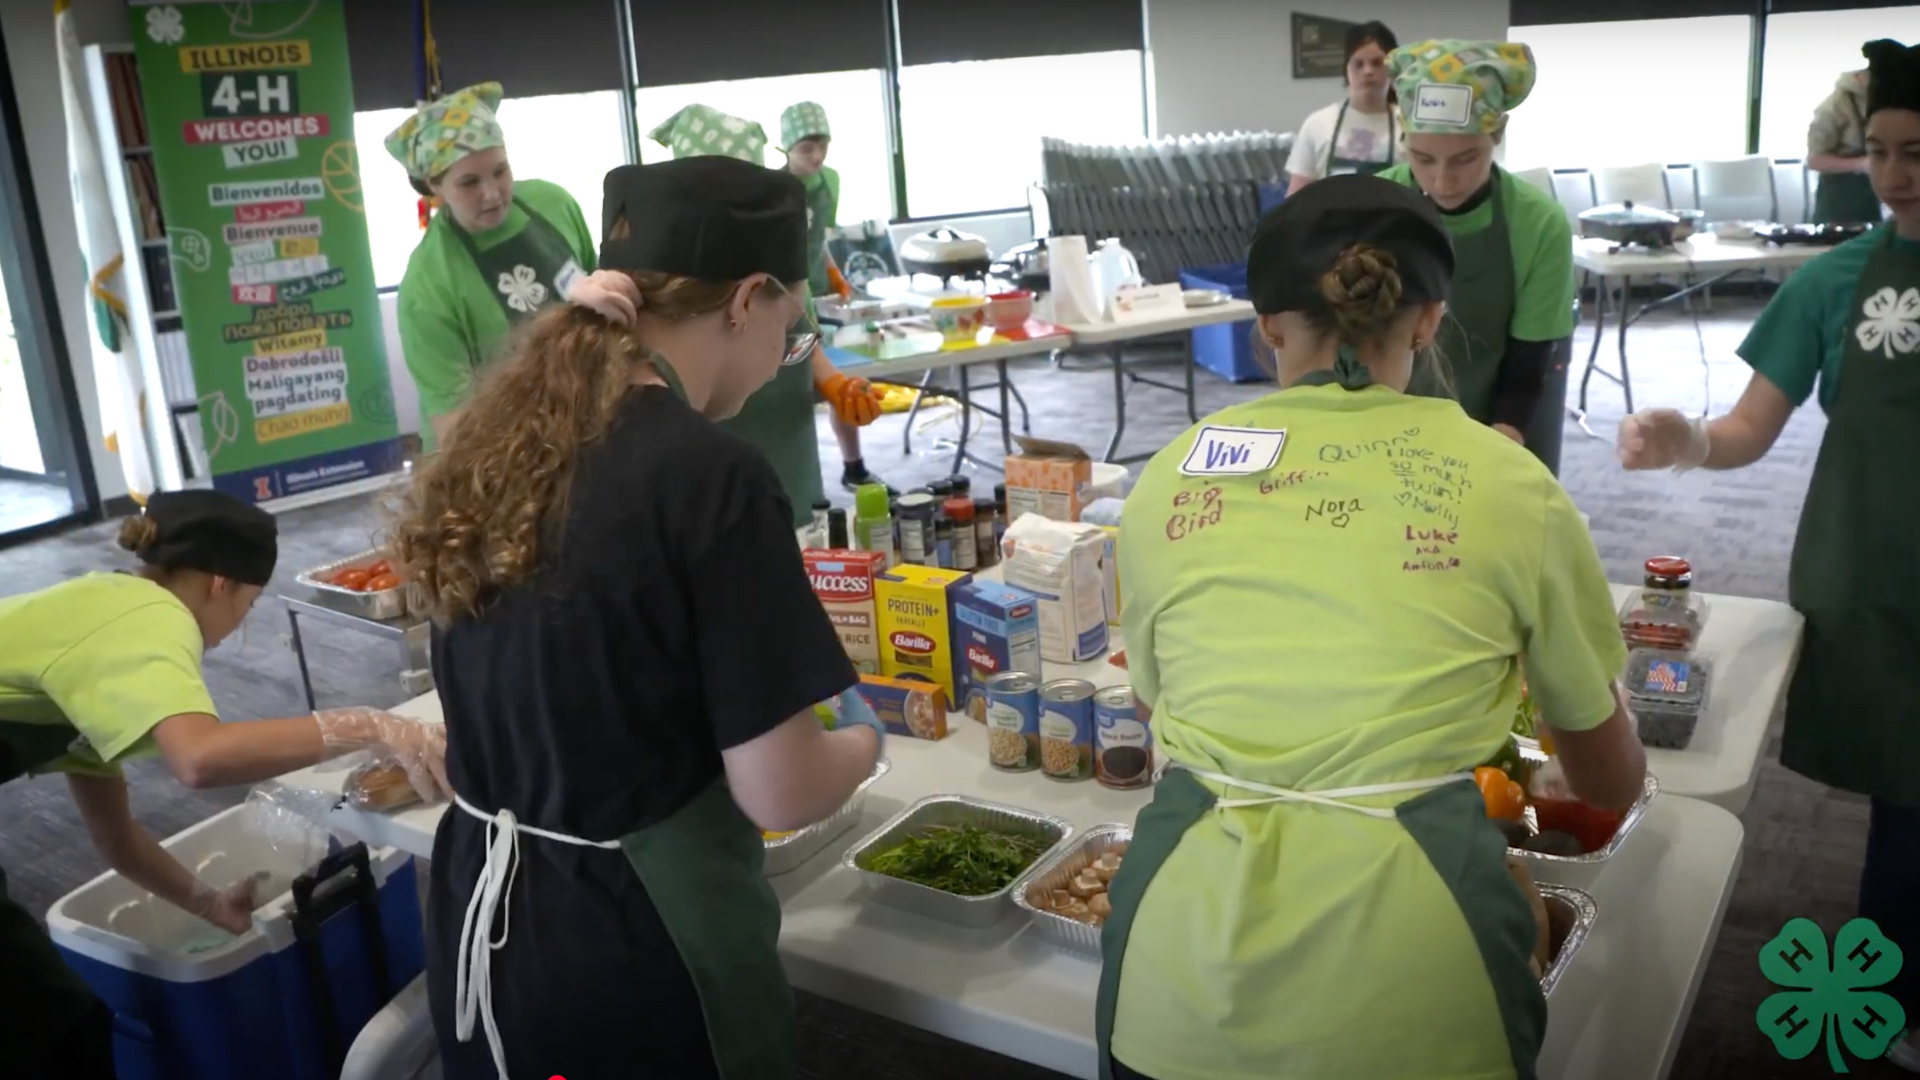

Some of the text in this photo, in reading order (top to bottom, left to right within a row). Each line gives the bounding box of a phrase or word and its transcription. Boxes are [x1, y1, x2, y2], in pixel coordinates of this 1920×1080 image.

[191, 44, 302, 68] ILLINOIS
[211, 75, 290, 113] 4-H
[194, 117, 319, 141] WELCOMES
[233, 146, 287, 162] YOU!
[212, 182, 321, 200] Bienvenidos
[227, 222, 319, 241] Bienvenue
[259, 332, 323, 353] Witamy
[248, 369, 345, 393] Maligayang
[255, 387, 342, 414] pagdating
[1205, 440, 1255, 470] Vivi
[1319, 436, 1409, 464] Quinn
[1400, 447, 1434, 460] love
[1259, 468, 1329, 494] Griffin
[1173, 484, 1222, 511] Big
[1166, 499, 1222, 541] Bird
[1305, 498, 1365, 521] Nora
[1406, 525, 1458, 545] Luke
[808, 573, 868, 592] uccess
[888, 598, 940, 618] PROTEIN+
[845, 634, 871, 645] RICE
[895, 634, 933, 651] Barilla
[968, 648, 996, 669] Barilla
